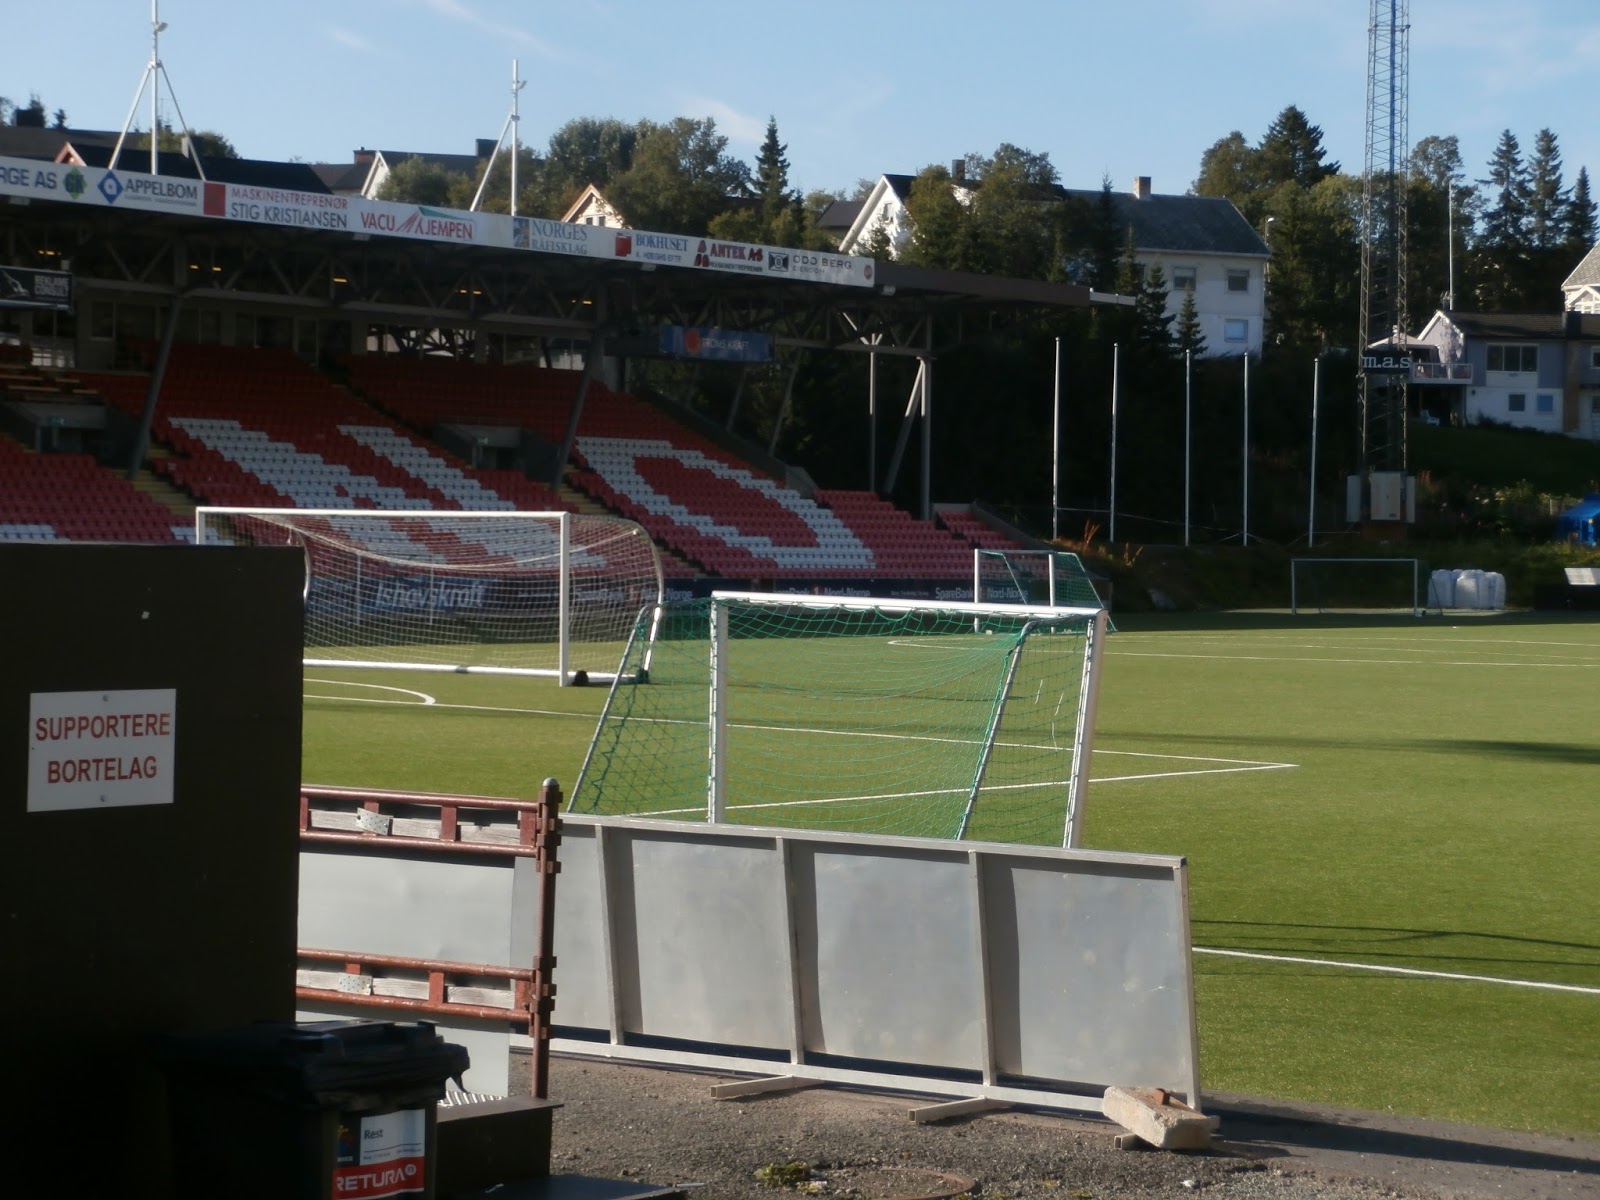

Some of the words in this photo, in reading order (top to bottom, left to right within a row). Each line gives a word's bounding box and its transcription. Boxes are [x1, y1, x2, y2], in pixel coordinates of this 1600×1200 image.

[34, 170, 58, 190] AS
[125, 178, 198, 200] APPELBOM
[231, 187, 348, 210] MASKINENTREPRENØR
[230, 202, 261, 221] STIG
[263, 205, 348, 229] KRISTIANSEN
[532, 220, 588, 241] NORGES
[636, 234, 688, 252] BOKHUSET
[710, 243, 746, 260] ANTEK
[793, 255, 818, 266] ODD
[821, 258, 852, 270] BERG
[1362, 356, 1411, 368] m.a.s
[35, 712, 171, 742] SUPPORTERE
[47, 755, 158, 784] BORTELAG
[364, 1128, 384, 1140] Rest
